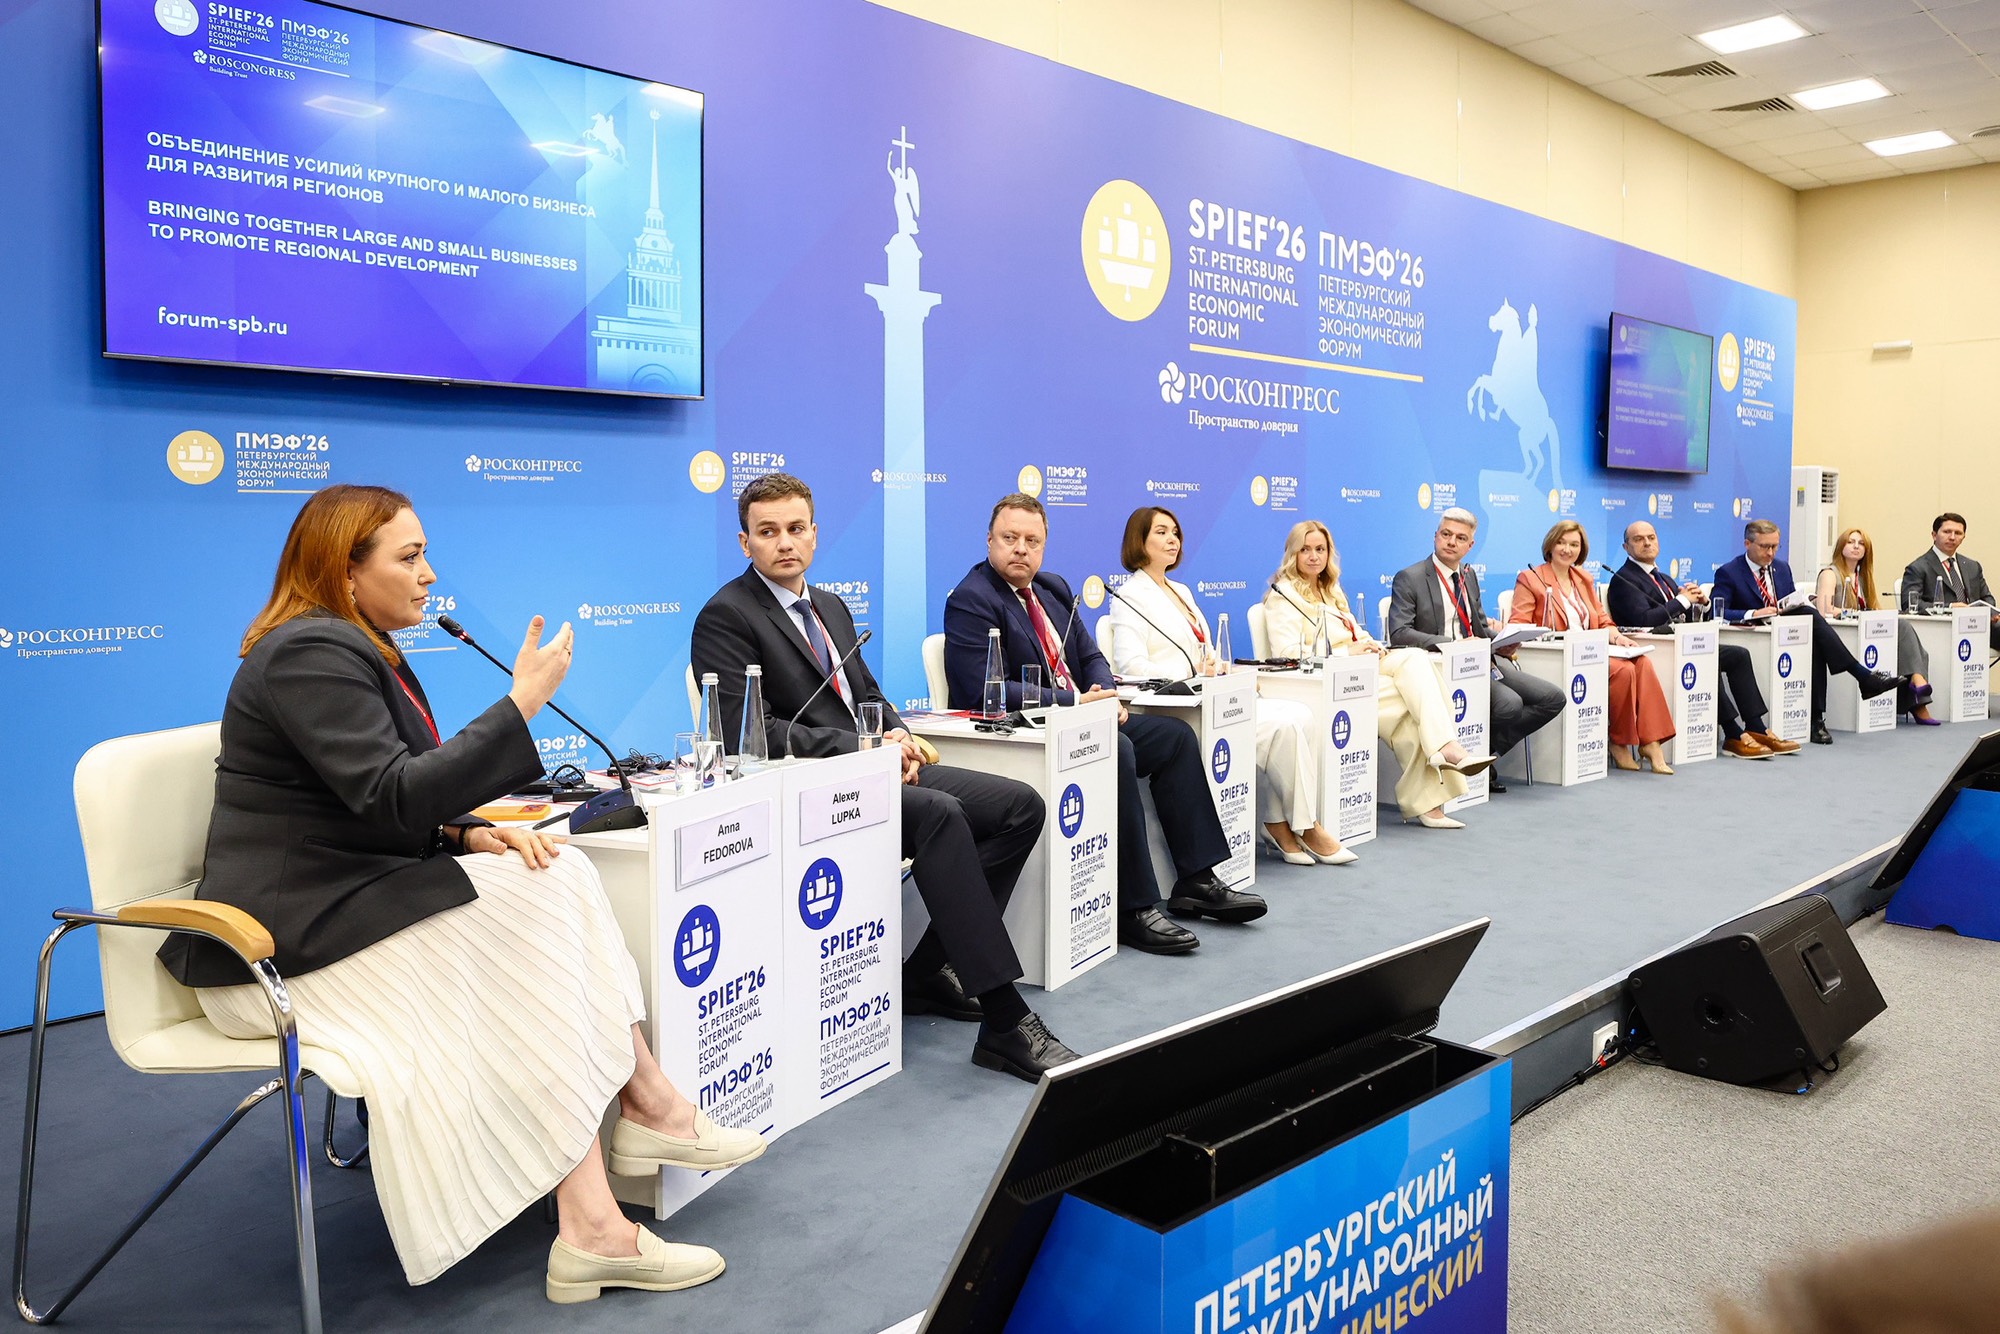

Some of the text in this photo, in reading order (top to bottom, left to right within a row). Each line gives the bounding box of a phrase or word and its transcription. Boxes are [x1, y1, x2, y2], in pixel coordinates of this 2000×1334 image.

[208, 2, 275, 28] SPIEF'26
[208, 16, 268, 35] ST. PETERSBURG
[208, 24, 270, 43] INTERNATIONAL
[208, 31, 251, 45] ECONOMIC
[281, 19, 350, 45] ПМЭФ'26
[281, 33, 341, 50] ПЕТЕРБУРГСКИЙ
[208, 38, 237, 48] FORUM
[281, 39, 350, 59] МЕЖДУНАРОДНЫЙ
[281, 46, 349, 66] ЭКОНОМИЧЕСКИЙ
[281, 53, 310, 65] ФОРУМ
[209, 54, 296, 81] ROSCONGRESS
[209, 66, 248, 79] Building Trust
[146, 131, 597, 219] ОБЪЕДИНЕНИЕ УСИЛИЙ КРУПНОГО И МАЛОГО БИЗНЕСА
[146, 154, 384, 205] ДЛЯ РАЗВИТИЯ РЕГИОНОВ
[148, 200, 578, 273] BRINGING TOGETHER LARGE AND SMALL BUSINESSES
[1188, 198, 1307, 262] SPIEF'26
[148, 222, 479, 278] TO PROMOTE REGIONAL DEVELOPMENT
[1318, 231, 1425, 288] ПМЭФ'26
[1189, 246, 1295, 285] ST. PETERSBURG
[1188, 269, 1299, 307] INTERNATIONAL
[1318, 274, 1412, 308] ПЕТЕРБУРГСКИЙ
[1188, 293, 1265, 322] ECONOMIC
[1318, 295, 1425, 331] МЕЖДУНАРОДНЫЙ
[157, 306, 288, 336] forum-spb.ru
[1188, 316, 1240, 340] FORUM
[1318, 316, 1423, 350] ЭКОНОМИЧЕСКИЙ
[1318, 337, 1362, 360] ФОРУМ
[1744, 336, 1776, 362] SPIEF'26
[1188, 372, 1341, 414] РОСКОНГРЕСС
[1189, 409, 1299, 436] Пространство доверия
[235, 431, 330, 452] ПМЭФ'26
[236, 450, 317, 461] ПЕТЕРБУРГСКИЙ
[236, 460, 331, 472] МЕЖДУНАРОДНЫЙ
[483, 458, 583, 473] РОСКОНГРЕСС
[732, 451, 786, 468] SPIEF'26
[236, 468, 329, 480] ЭКОНОМИЧЕСКИЙ
[483, 473, 555, 483] Пространство доверия
[883, 471, 948, 483] ROSCONGRESS
[1046, 465, 1088, 479] ПМЭФ'26
[1271, 476, 1298, 487] SPIEF'26
[236, 478, 275, 488] ФОРУМ
[594, 602, 682, 617] ROSCONGRESS
[594, 617, 633, 628] Building Trust
[16, 625, 165, 646] РОСКОНГРЕСС
[391, 630, 430, 640] ONOMIC
[17, 645, 123, 659] Пространство доверия
[905, 697, 932, 711] SPIE
[1578, 705, 1602, 718] SPIEF'26
[1079, 730, 1091, 742] Kirill
[1458, 723, 1483, 737] SPIEF'26
[540, 750, 578, 761] УРГСКИЙ
[1069, 744, 1100, 761] KUZNETSOV
[1577, 739, 1604, 753] ПМЭФ'26
[1340, 750, 1370, 766] SPIEF'26
[832, 789, 861, 808] Alexey
[1220, 782, 1249, 802] SPIEF'26
[1340, 791, 1372, 810] ПМЭФ'26
[831, 808, 861, 826] LUPKA
[717, 820, 741, 838] Anna
[1070, 832, 1108, 862] SPIEF'26
[1227, 830, 1251, 850] МЭФ'26
[703, 837, 754, 865] FEDOROVA
[1070, 862, 1106, 883] INTERNATIONAL
[1077, 853, 1104, 872] PETERSBURG
[1070, 875, 1095, 892] ECONOMIC
[1070, 888, 1088, 902] FORUM
[1070, 891, 1111, 925] ПМЭФ'26
[1070, 911, 1106, 936] ПЕТЕРБУРГСКИЙ
[1070, 916, 1112, 945] МЕЖДУНАРОДНЫЙ
[820, 917, 885, 960] SPIEF'26
[1070, 926, 1111, 954] ЭКОНОМИЧЕСКИЙ
[820, 943, 879, 975] ST. PETERSBURG
[1070, 949, 1088, 963] ФОРУМ
[820, 955, 881, 987] INTERNATIONAL
[698, 966, 766, 1020] SPIEF'26
[820, 972, 863, 999] ECONOMIC
[820, 991, 848, 1011] FORUM
[698, 994, 760, 1037] ST. PETERSBURG
[820, 991, 891, 1041] ПМЭФ'26
[698, 1007, 762, 1050] INTERNATIONAL
[820, 1017, 882, 1056] ПЕТЕРБУРГСКИЙ
[698, 1030, 743, 1064] ECONOMIC
[820, 1024, 891, 1066] МЕЖДУНАРОДНЫЙ
[698, 1052, 729, 1078] FORUM
[820, 1037, 890, 1079] ЭКОНОМИЧЕСКИЙ
[699, 1047, 773, 1110] ПМЭФ'26
[820, 1070, 850, 1091] ФОРУМ
[706, 1076, 764, 1119] ЕТЕРБУРГСКИЙ
[1195, 1147, 1457, 1334] ПЕТЕРБУРГСКИЙ
[1238, 1173, 1495, 1334] ЖДУНАРОДНЫЙ
